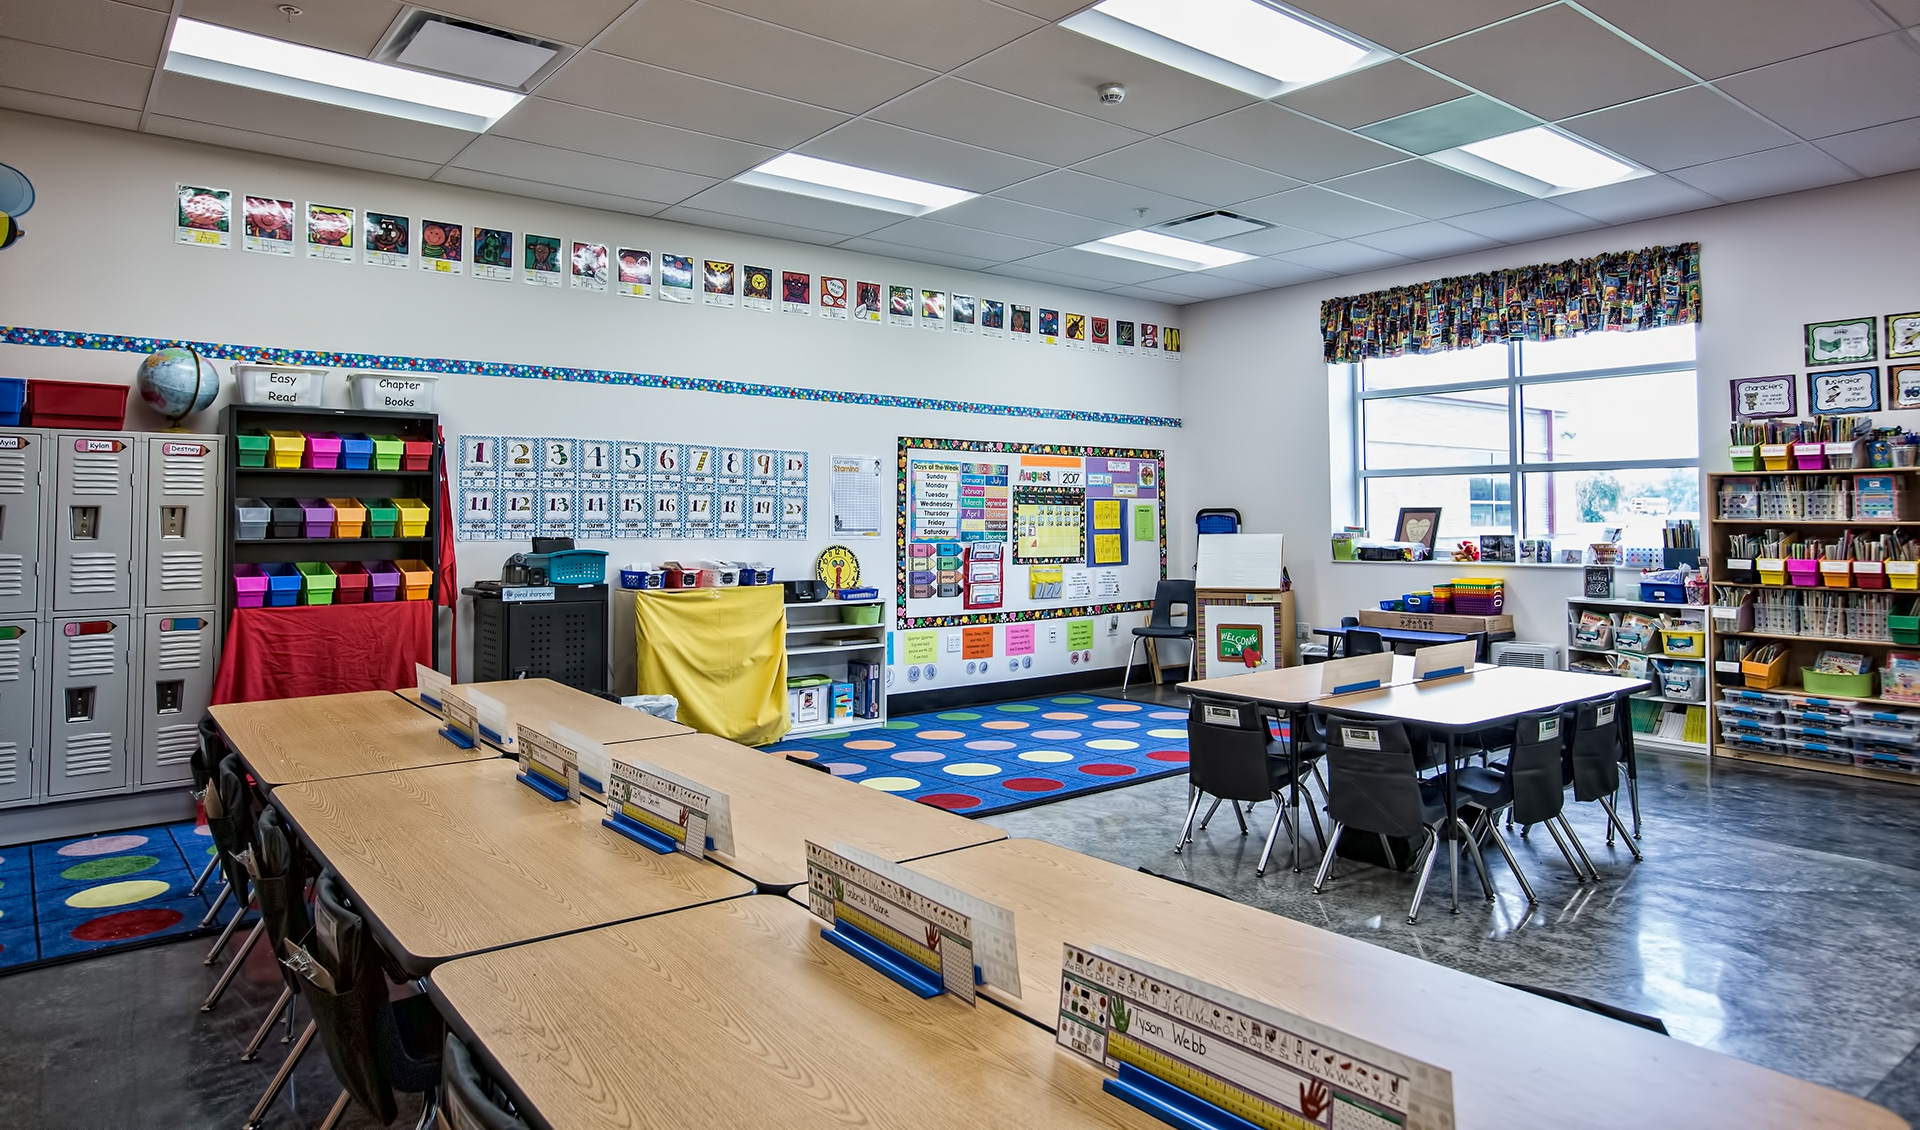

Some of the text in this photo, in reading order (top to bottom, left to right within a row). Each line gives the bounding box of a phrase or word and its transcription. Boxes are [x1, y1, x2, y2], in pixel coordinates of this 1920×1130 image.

[261, 239, 277, 253] Bb
[322, 246, 336, 259] Cc
[381, 253, 396, 266] Dd
[270, 372, 298, 387] Easy
[379, 379, 421, 392] Chapter
[1744, 383, 1783, 392] characters
[268, 391, 297, 402] Read
[385, 397, 414, 407] Books
[89, 441, 110, 450] Kylan
[470, 442, 489, 463] 1
[511, 443, 530, 464] 2
[551, 444, 568, 466] 3
[587, 446, 606, 467] 4
[625, 446, 641, 469] 5
[659, 449, 674, 470] 6
[693, 451, 708, 471] 7
[727, 452, 740, 474] 8
[757, 454, 770, 475] 9
[913, 463, 927, 471] Days
[833, 465, 859, 473] Stamina
[1018, 469, 1051, 482] August
[962, 476, 984, 485] January
[991, 477, 1003, 486] July
[962, 486, 984, 496] February
[468, 497, 491, 511] 11
[508, 497, 530, 511] 12
[547, 497, 570, 512] 13
[585, 497, 606, 512] 14
[621, 498, 642, 513] 15
[656, 498, 676, 513] 16
[690, 500, 708, 513] 17
[722, 500, 739, 514] 18
[754, 501, 770, 514] 19
[964, 498, 982, 506] March
[985, 499, 1007, 507] September
[966, 510, 980, 518] April
[927, 519, 945, 527] Friday
[513, 589, 554, 599] pencil sharpener
[1220, 632, 1258, 646] WELCOME
[845, 882, 866, 906] Gabriel
[1064, 961, 1400, 1106] Aa Bb Cc Dd Ee Ff Gg Hh Ii Jj Kk Ll Mm Nn Oo Pp Qq Rr Ss Tt Uu Vv Ww Xx Yy Zz
[1132, 1006, 1207, 1056] Tyson Webb
